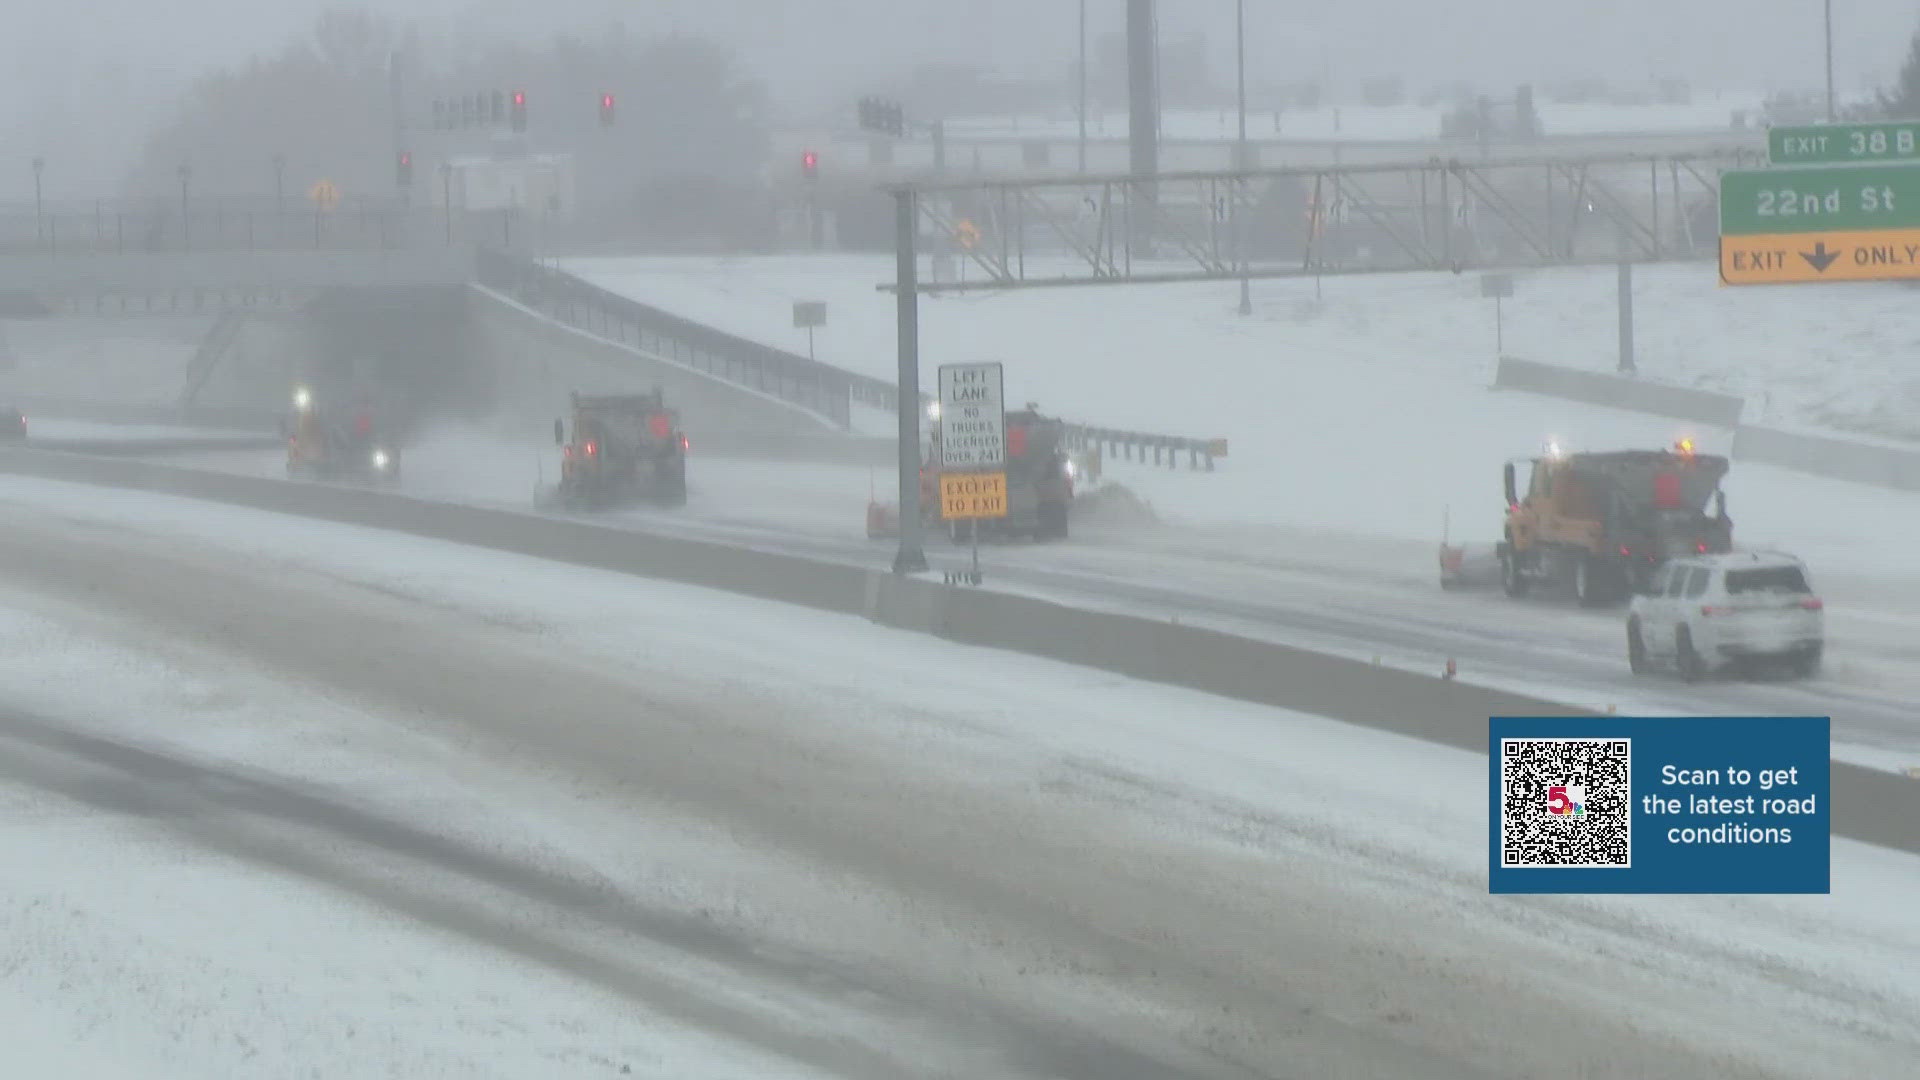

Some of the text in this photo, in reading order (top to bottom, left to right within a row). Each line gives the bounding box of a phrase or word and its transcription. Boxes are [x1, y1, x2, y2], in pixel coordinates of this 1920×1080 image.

[1783, 129, 1915, 154] EXIT 38 B
[1756, 185, 1895, 216] 22nd St
[1733, 244, 1920, 271] EXIT ONLY
[953, 370, 986, 383] LEFT
[953, 387, 989, 401] LANE
[963, 407, 979, 418] NO
[952, 421, 994, 433] TRUCKS
[946, 436, 999, 448] LICENSED
[946, 479, 999, 495] EXCEPT
[948, 496, 1001, 512] TO EXIT
